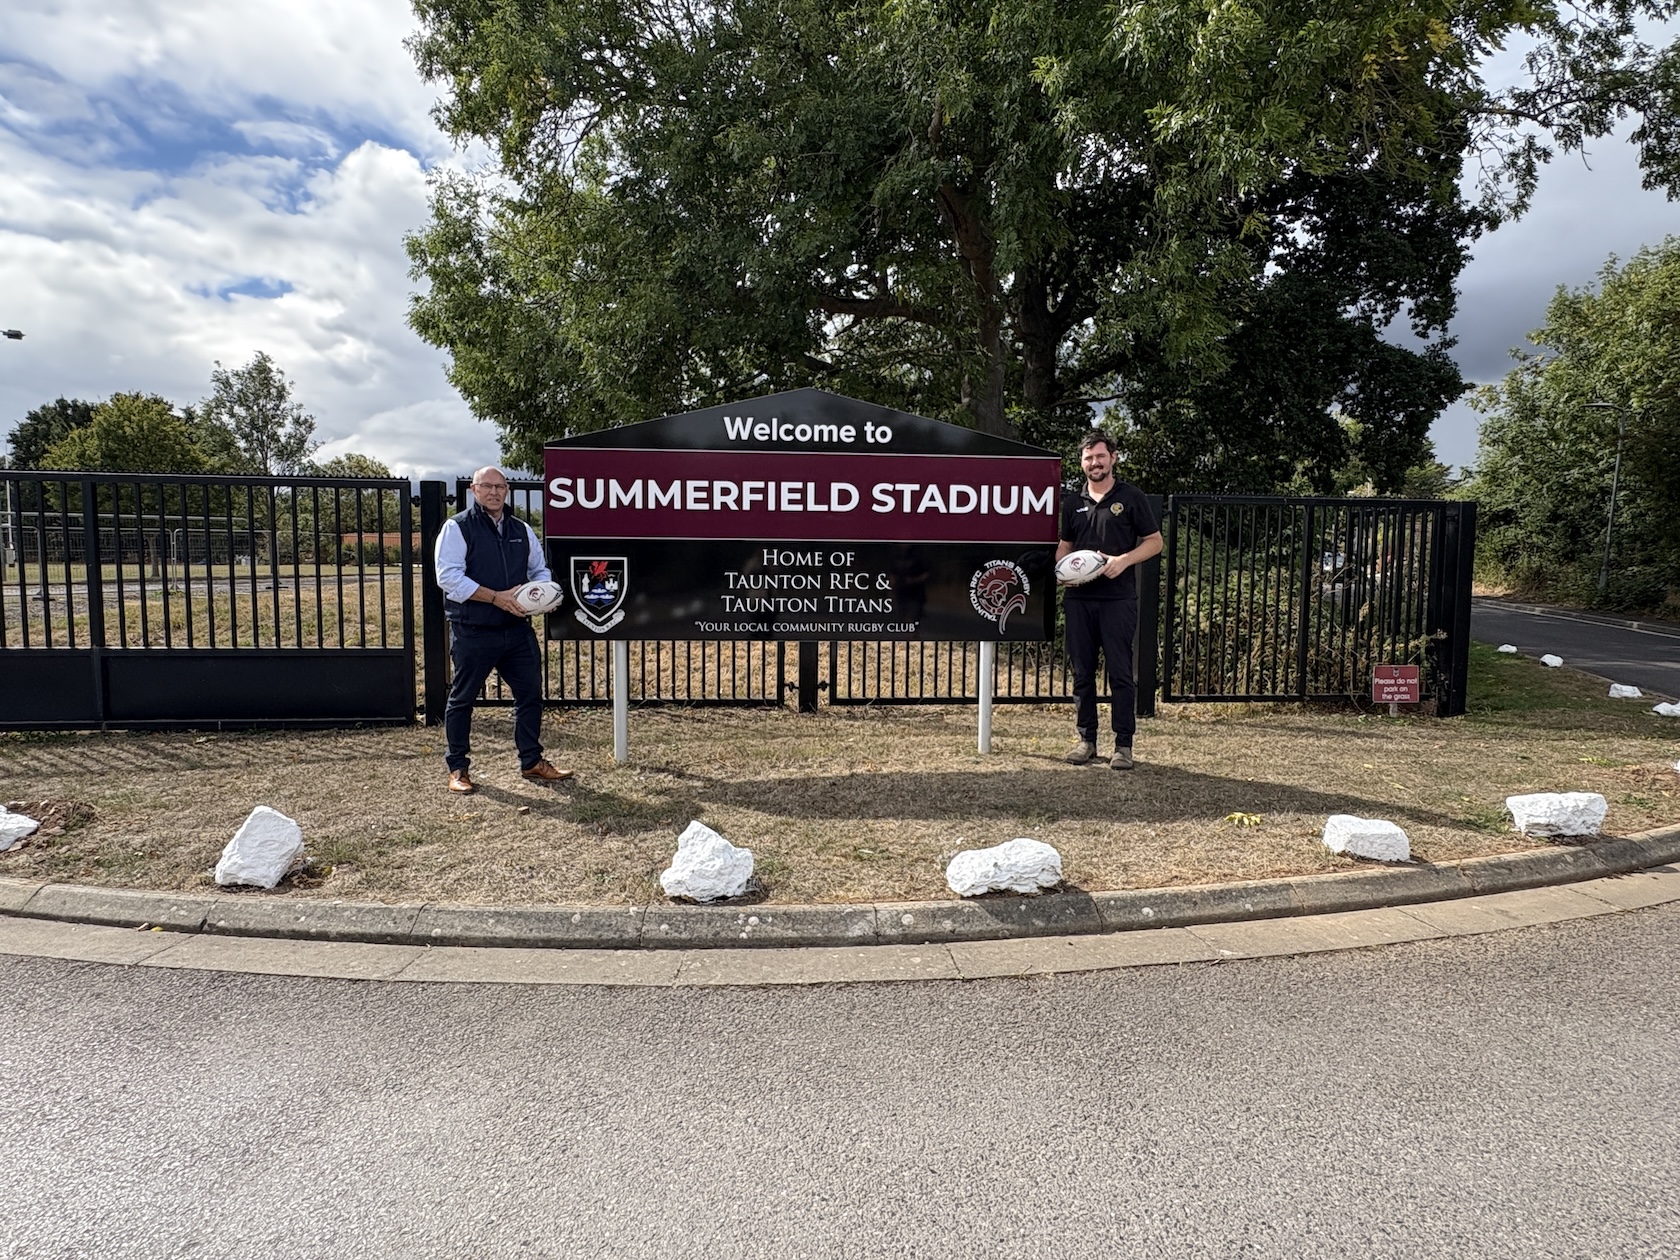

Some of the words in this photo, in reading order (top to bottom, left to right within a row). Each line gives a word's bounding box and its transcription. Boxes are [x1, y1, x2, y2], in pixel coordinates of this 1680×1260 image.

[723, 417, 857, 442] Welcome
[864, 421, 893, 444] to
[549, 477, 860, 512] SUMMERFIELD
[871, 483, 1055, 515] STADIUM
[763, 549, 823, 566] HOME
[830, 551, 855, 566] OF
[724, 572, 821, 590] TAUNTON
[829, 573, 870, 590] RFC
[875, 573, 893, 590] &
[970, 570, 982, 588] RFC
[984, 560, 1015, 569] TITANS
[1014, 566, 1030, 595] RUGBY
[721, 595, 818, 613] TAUNTON
[824, 596, 893, 613] TITANS
[969, 589, 997, 621] TAUNTON
[734, 622, 770, 632] LOCAL
[772, 622, 845, 632] COMMUNITY
[848, 623, 885, 633] RUGBY
